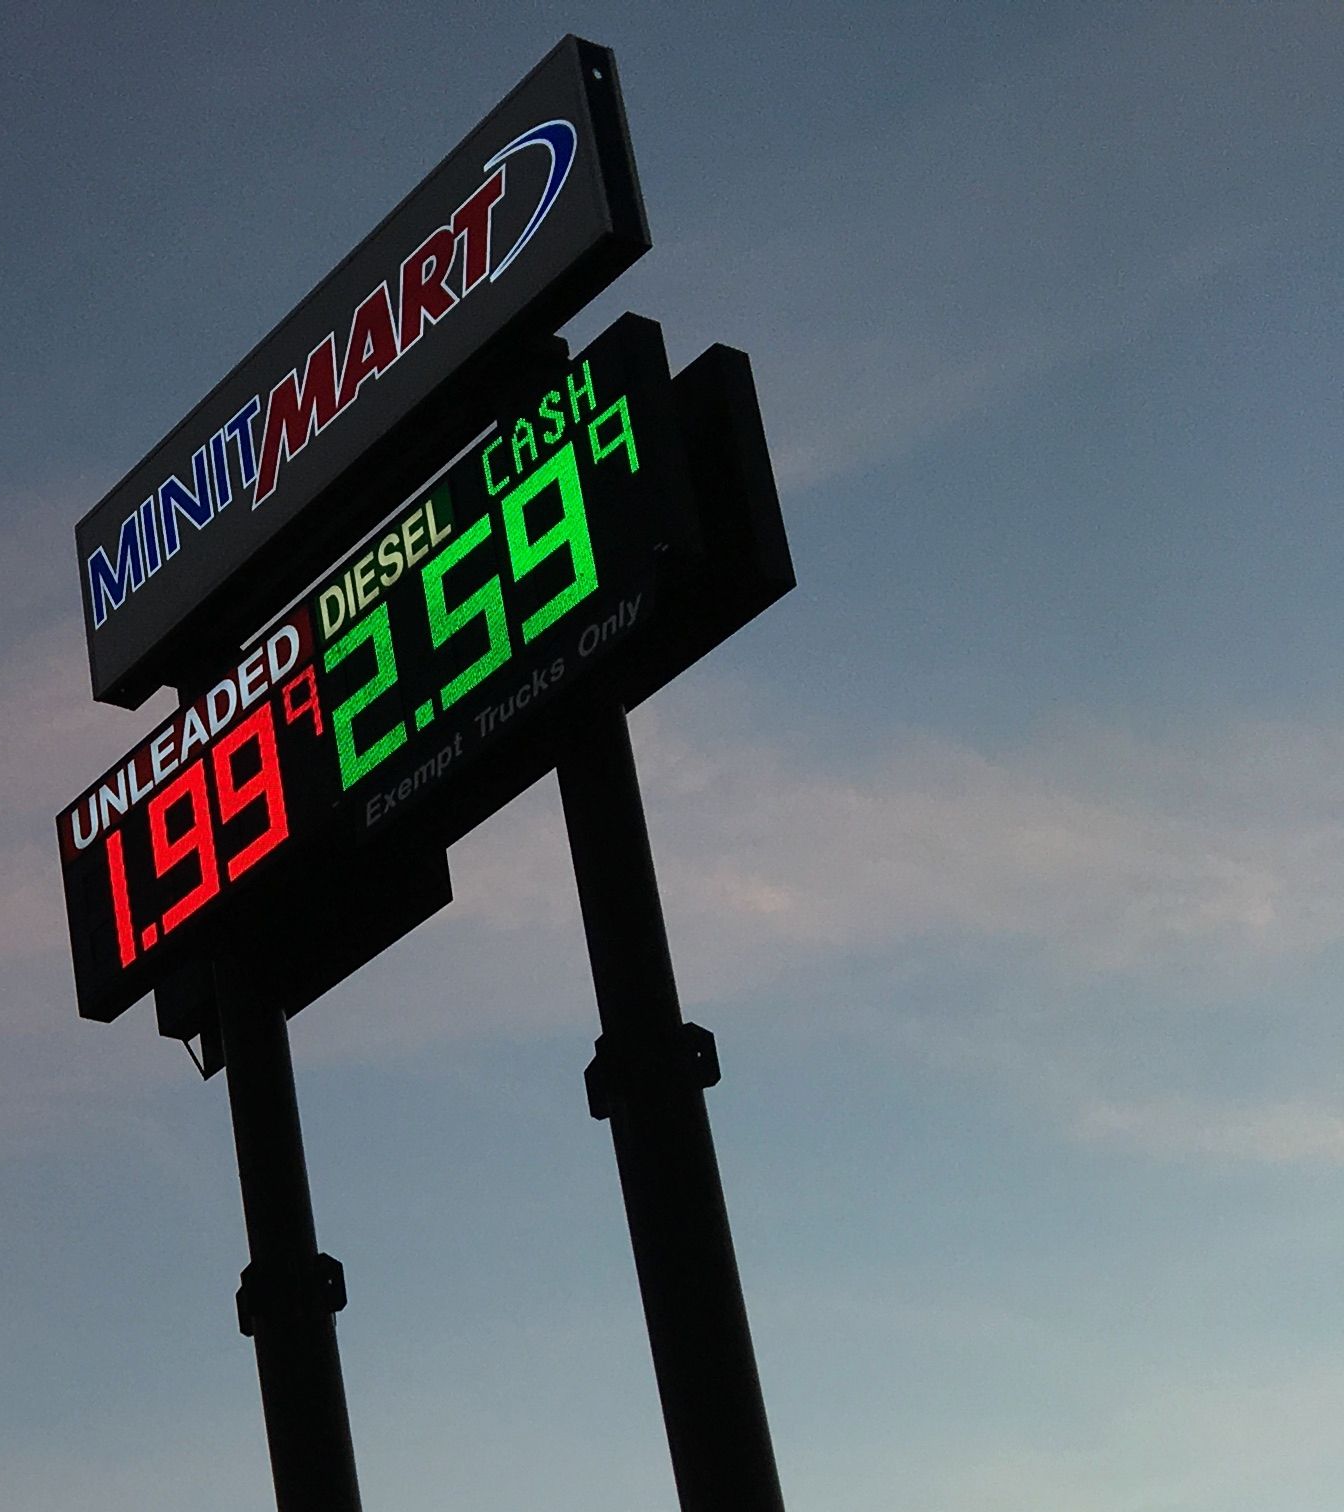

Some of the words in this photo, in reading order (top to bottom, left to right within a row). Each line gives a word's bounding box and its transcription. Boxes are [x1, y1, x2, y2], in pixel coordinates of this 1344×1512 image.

[481, 360, 597, 496] CASH
[320, 500, 452, 641] DIESEL
[70, 624, 301, 852] UNLEADED
[366, 732, 463, 828] Exempt
[474, 657, 566, 738] Trucks
[577, 592, 642, 657] Only
